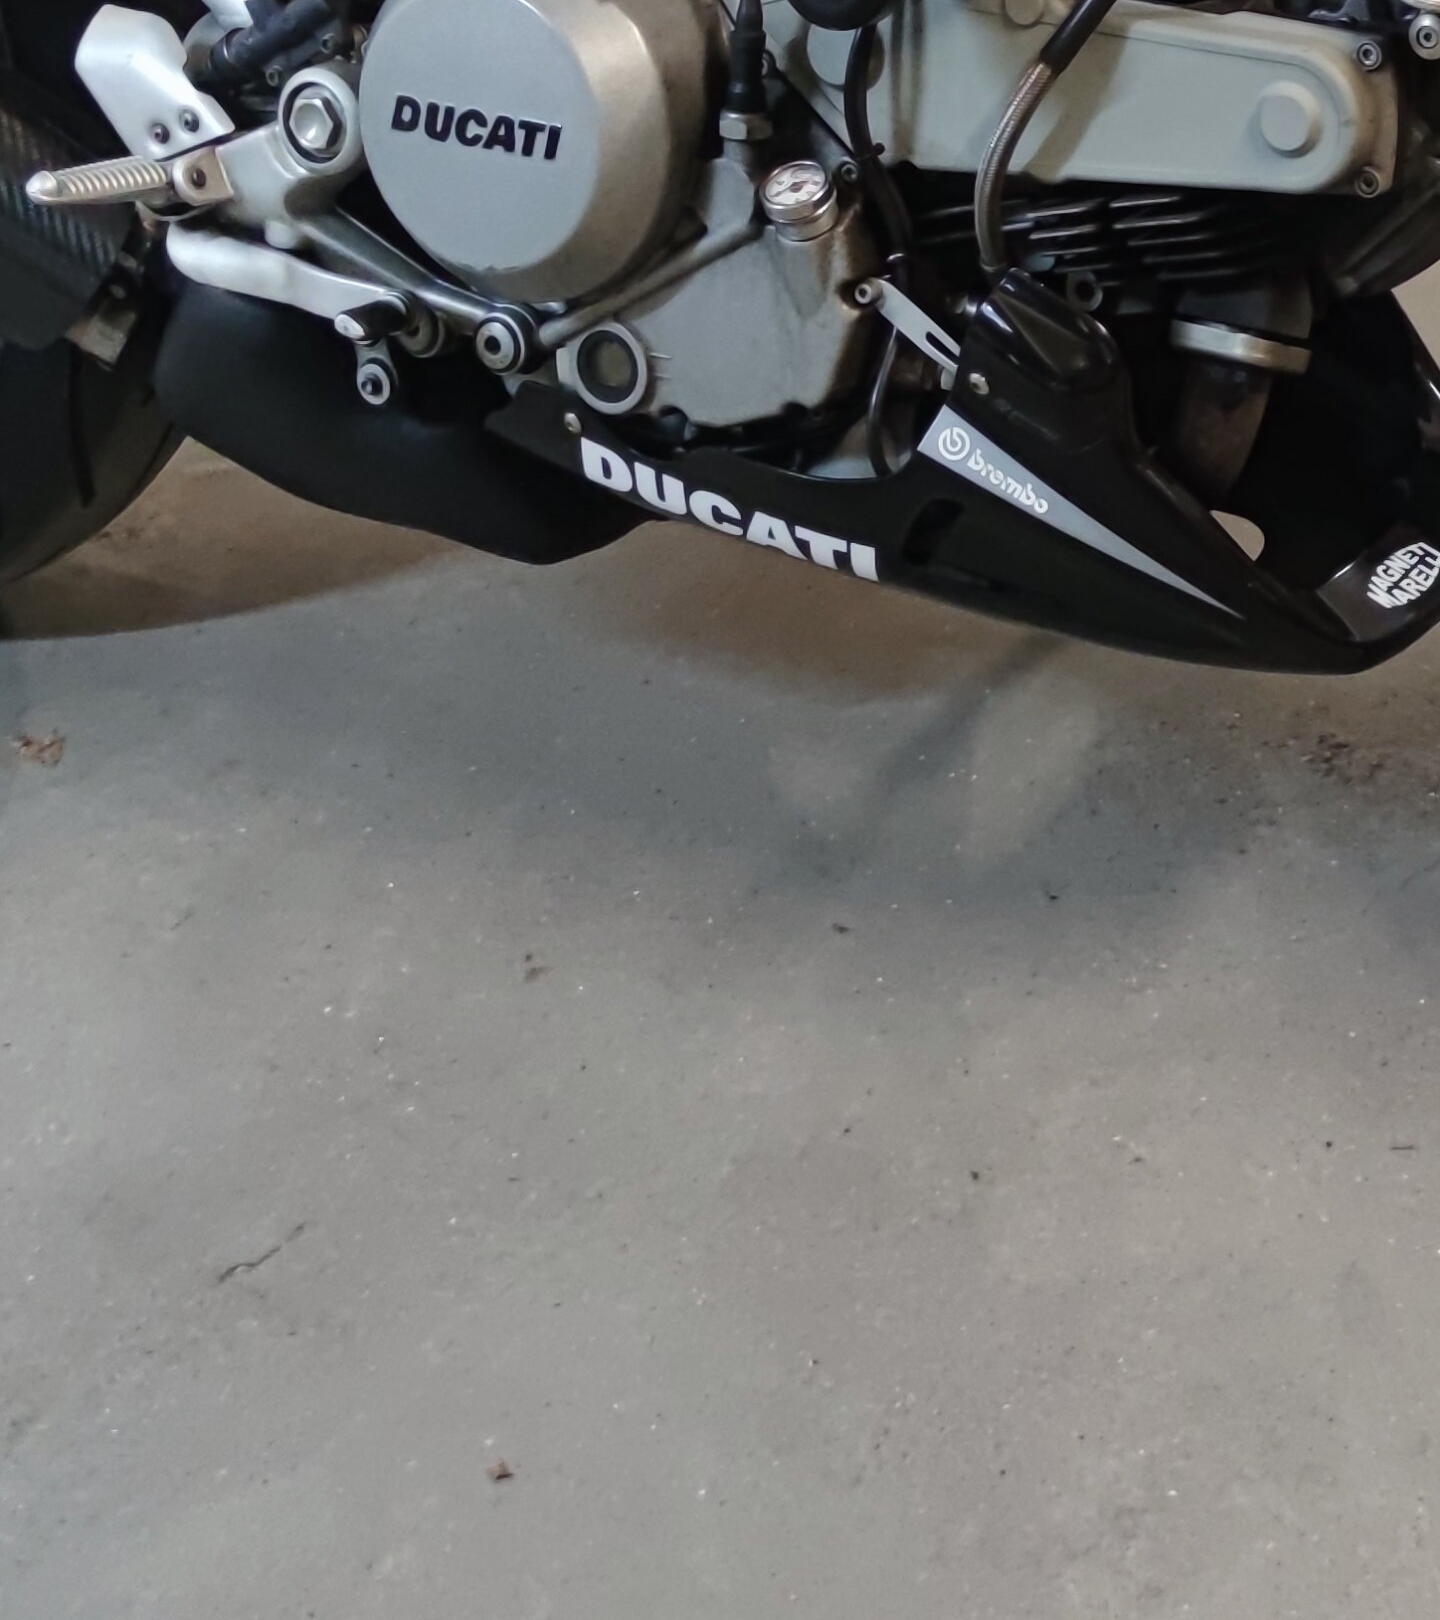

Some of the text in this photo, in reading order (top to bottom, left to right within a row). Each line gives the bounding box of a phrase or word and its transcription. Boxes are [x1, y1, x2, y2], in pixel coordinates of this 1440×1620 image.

[390, 93, 563, 161] DUCATI
[580, 436, 880, 583] DUCATI
[966, 447, 1049, 514] brembo
